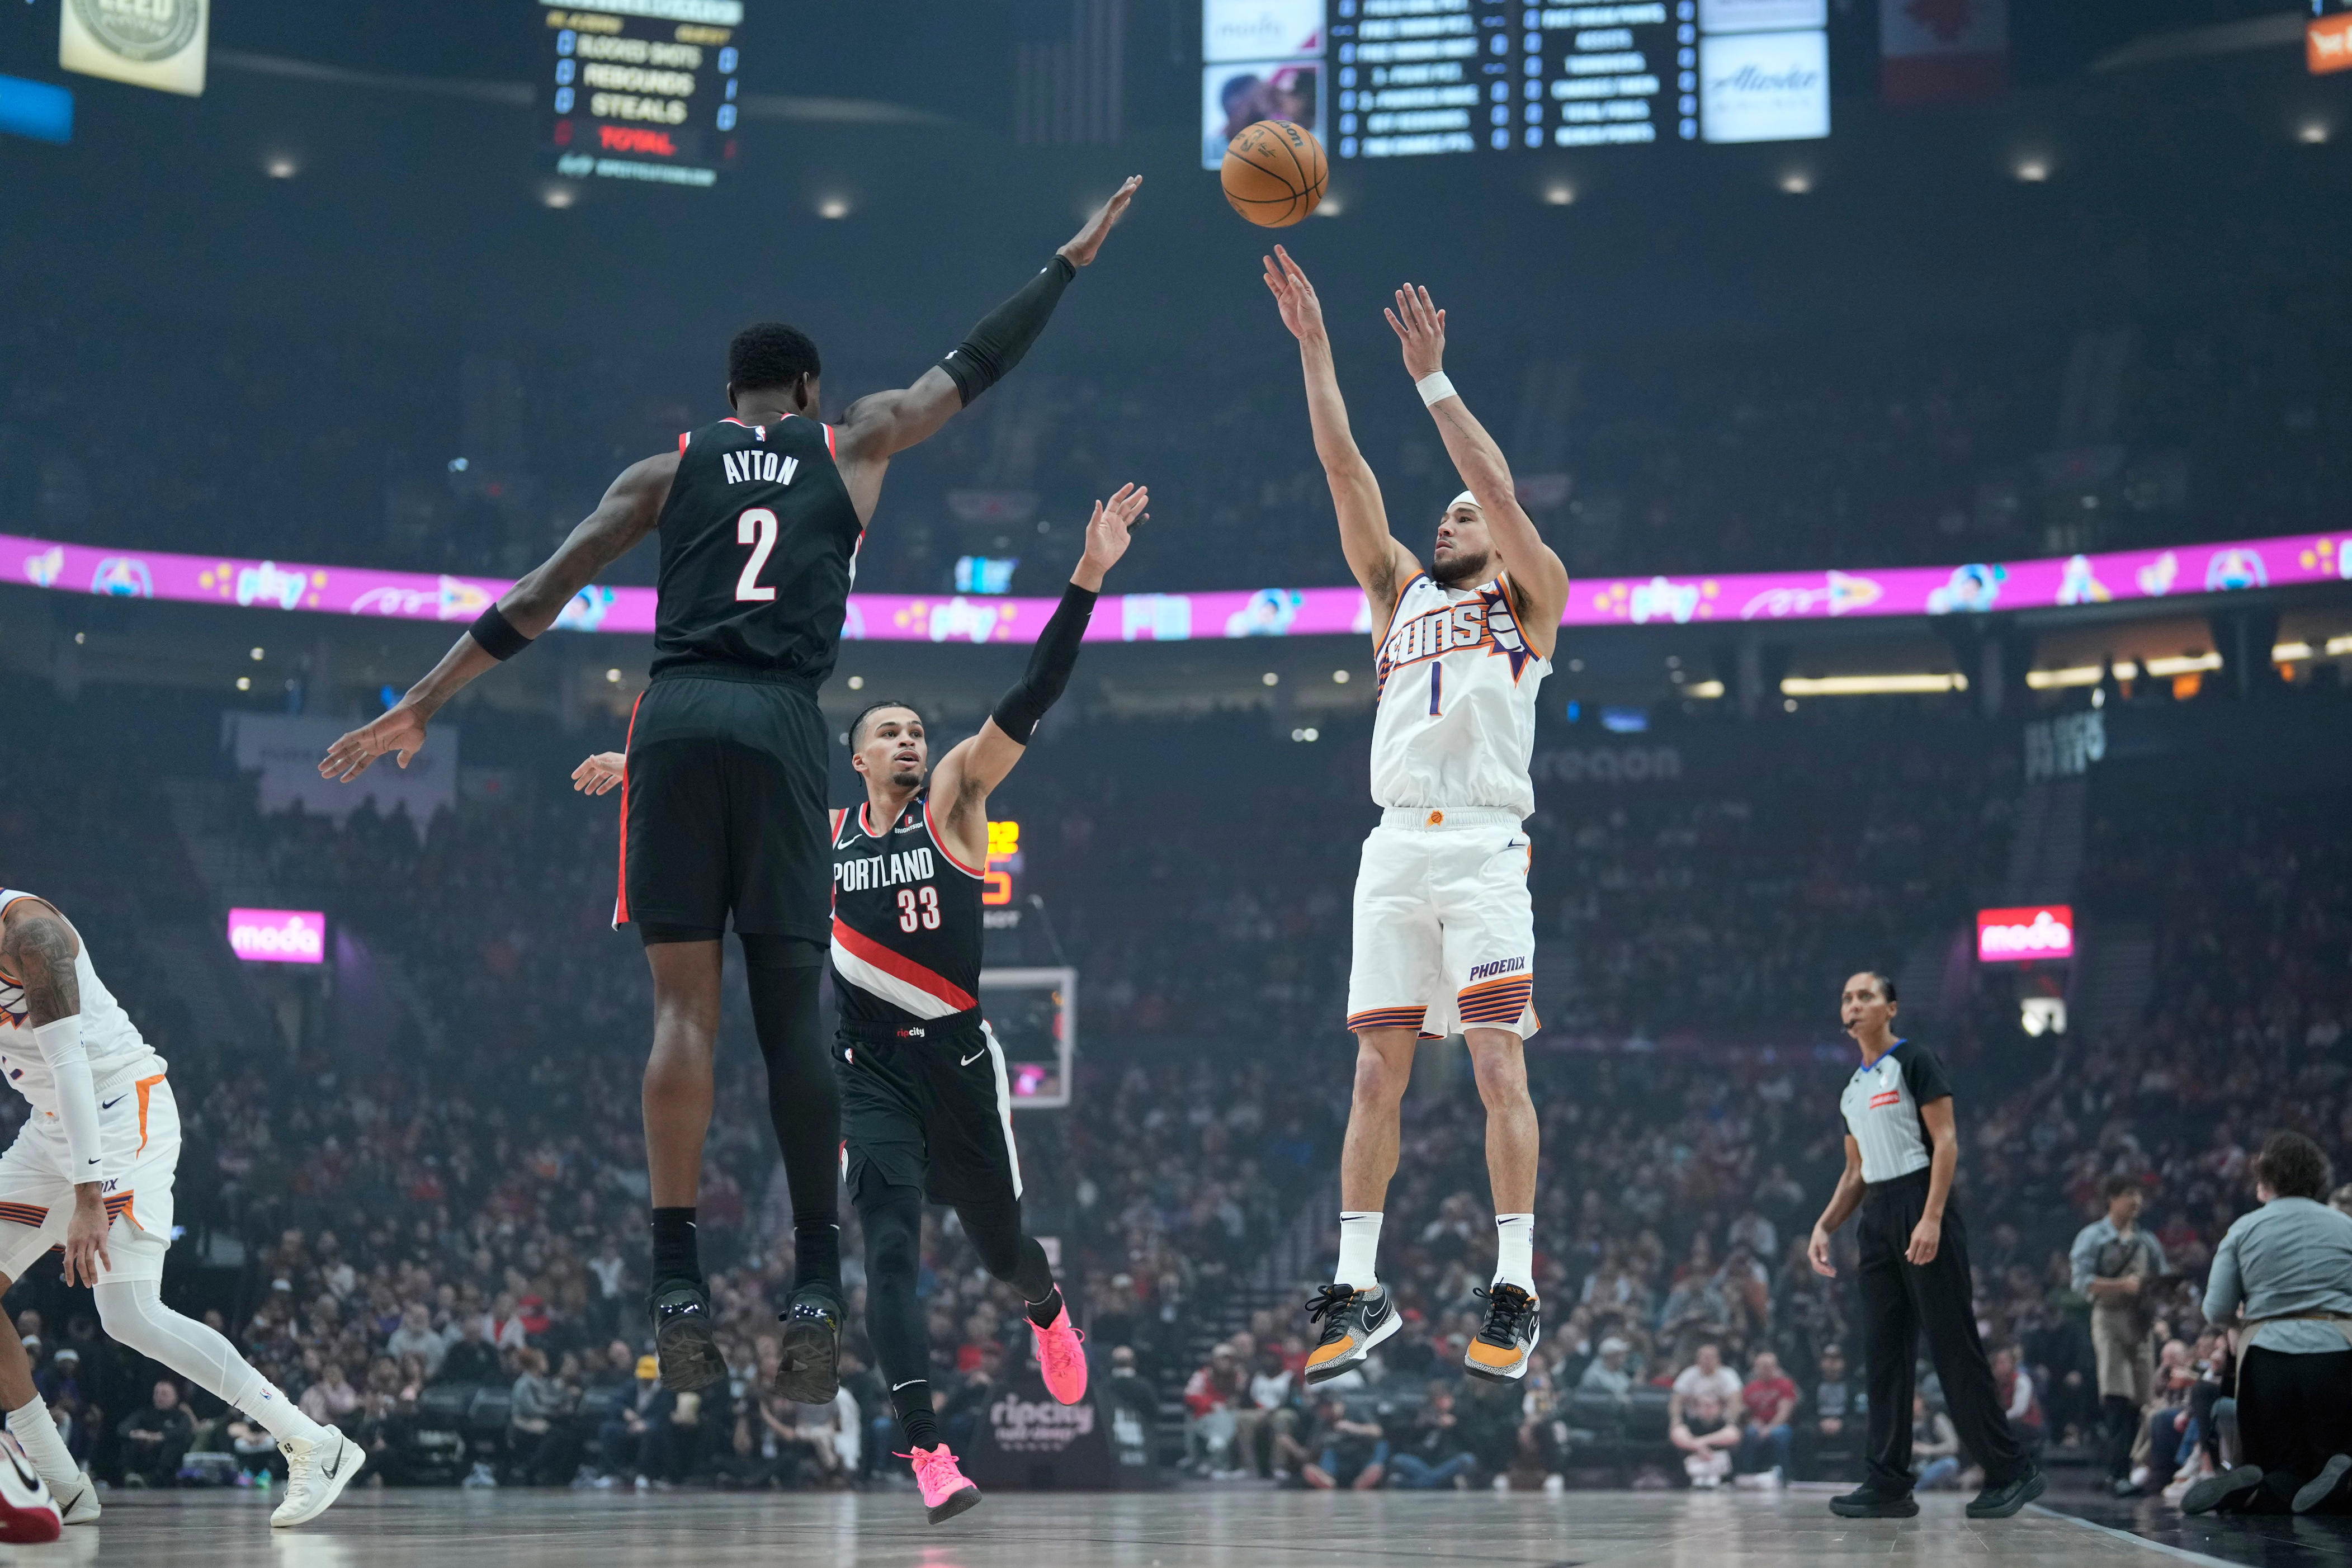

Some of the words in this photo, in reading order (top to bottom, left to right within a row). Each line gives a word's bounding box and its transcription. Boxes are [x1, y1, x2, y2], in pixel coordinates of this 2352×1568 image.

[591, 92, 687, 125] STEALS
[722, 450, 799, 485] AYTON
[735, 507, 778, 602] 2
[1429, 661, 1443, 716] 1
[895, 821, 923, 834] BRIGHTSIDE
[834, 847, 934, 894] PORTLAND
[897, 885, 941, 933] 33
[231, 915, 322, 951] moda
[1470, 956, 1525, 981] PHOENIX
